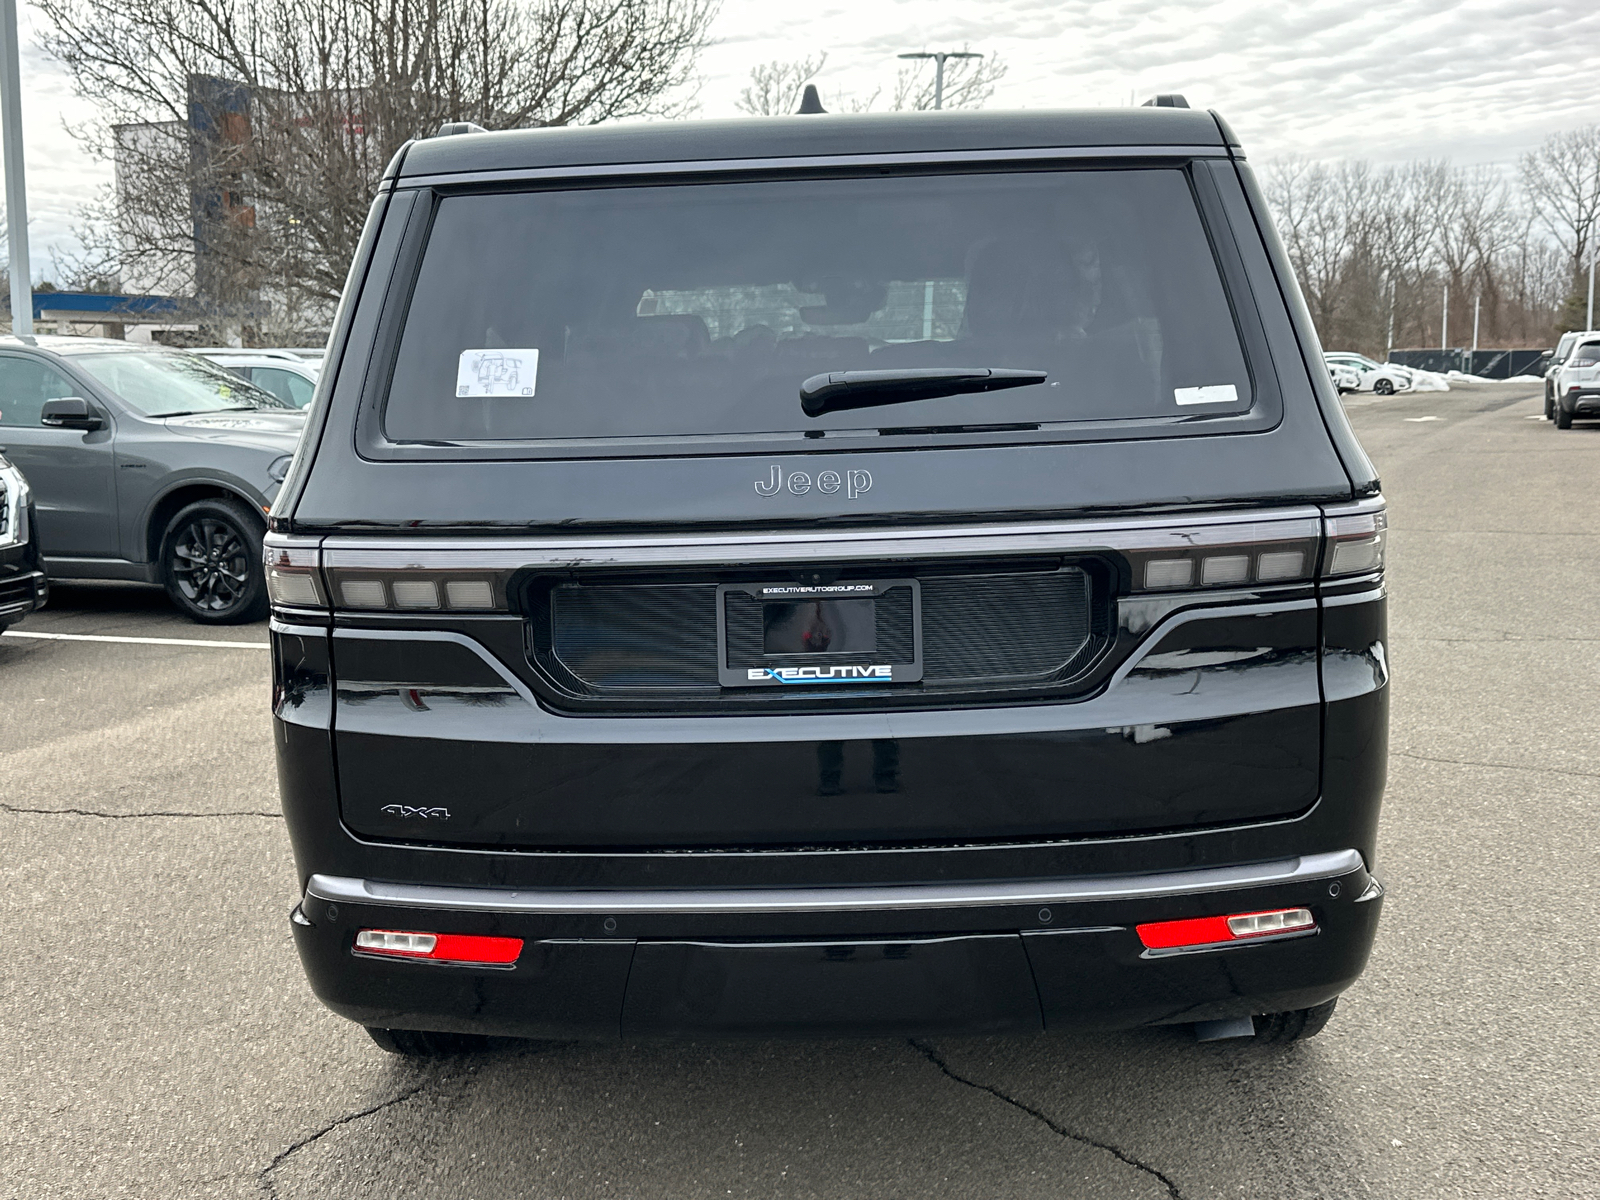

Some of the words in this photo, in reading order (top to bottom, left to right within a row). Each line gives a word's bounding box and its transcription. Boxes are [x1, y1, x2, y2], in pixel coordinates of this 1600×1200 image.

[754, 464, 873, 500] Jeep
[762, 584, 874, 594] EXECUTIVEAUTOGROUP.COM
[747, 665, 892, 682] EXECUTIVE
